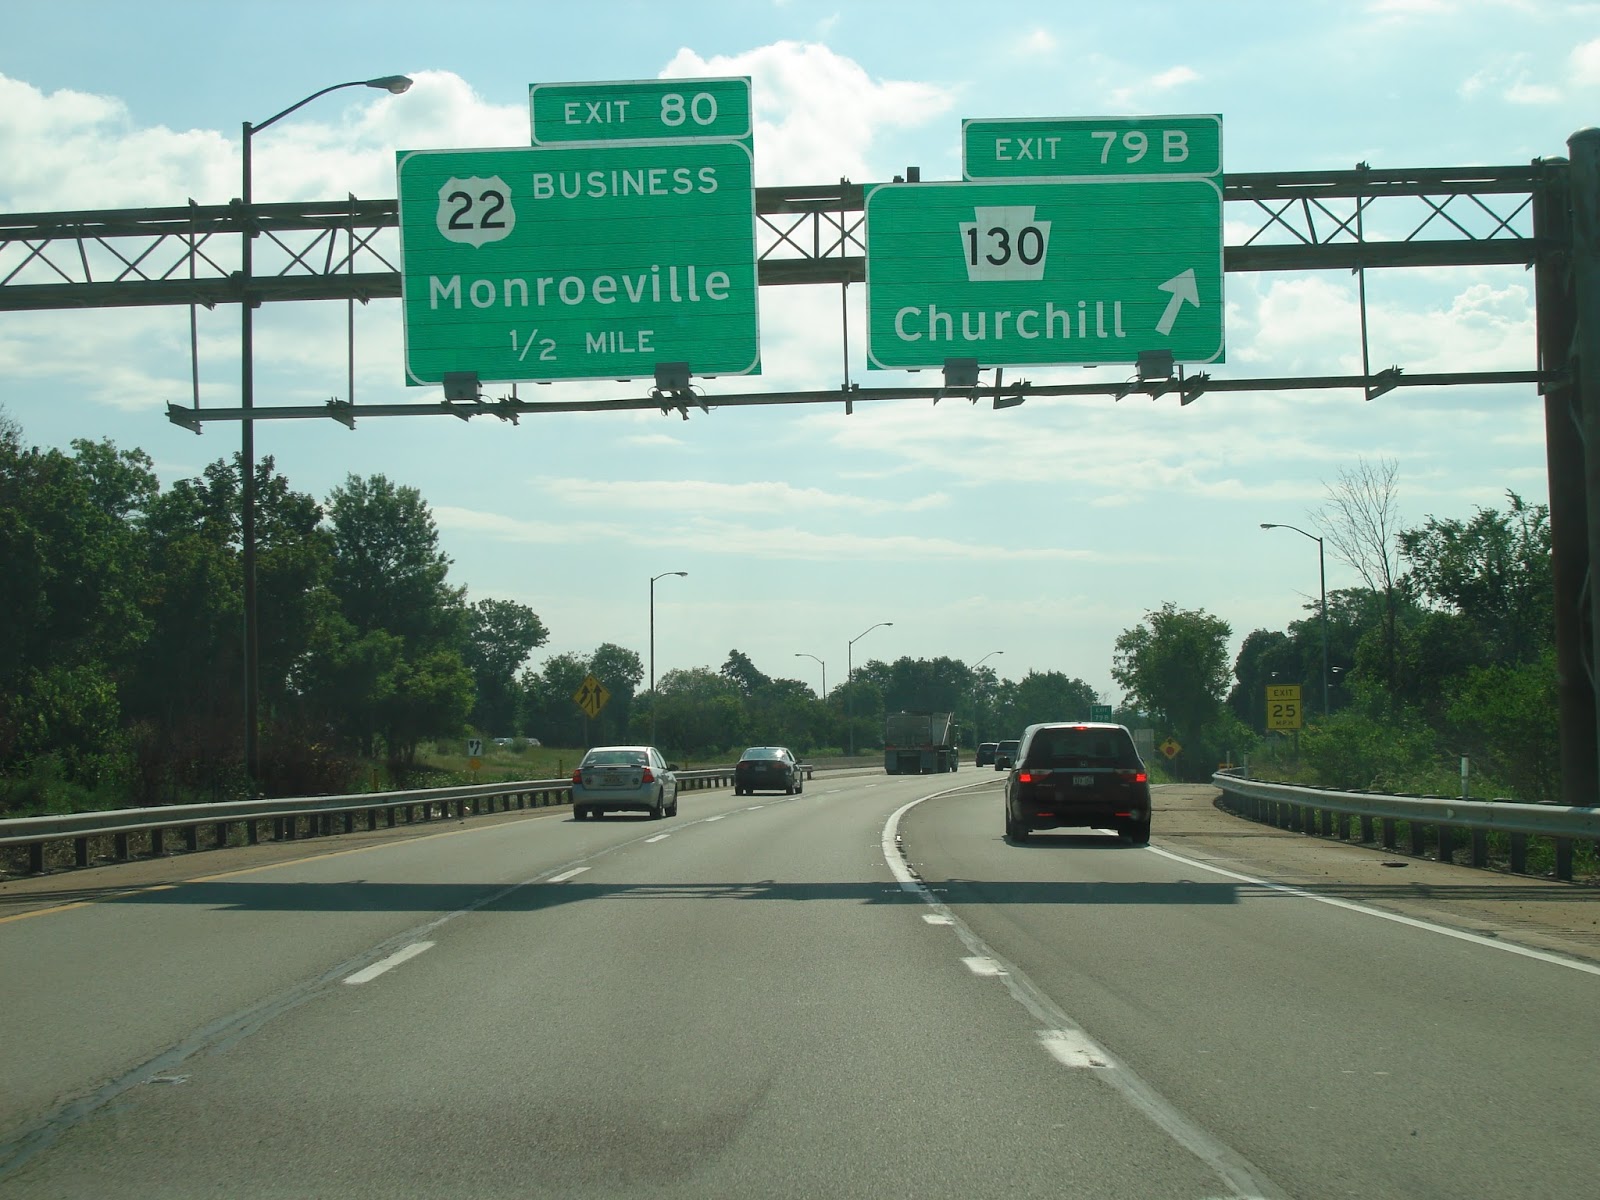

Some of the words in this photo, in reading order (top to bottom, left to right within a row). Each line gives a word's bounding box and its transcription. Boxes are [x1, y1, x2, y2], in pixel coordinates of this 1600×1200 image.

[564, 101, 630, 124] EXIT
[660, 92, 718, 126] 80
[995, 137, 1061, 160] EXIT
[533, 167, 718, 199] BUSINESS
[447, 190, 506, 230] 22
[967, 226, 1044, 266] 130
[429, 265, 730, 310] Monroeville
[894, 300, 1126, 341] Churchill
[586, 330, 655, 354] MILE
[1273, 689, 1294, 697] EXIT
[1272, 704, 1296, 718] 25
